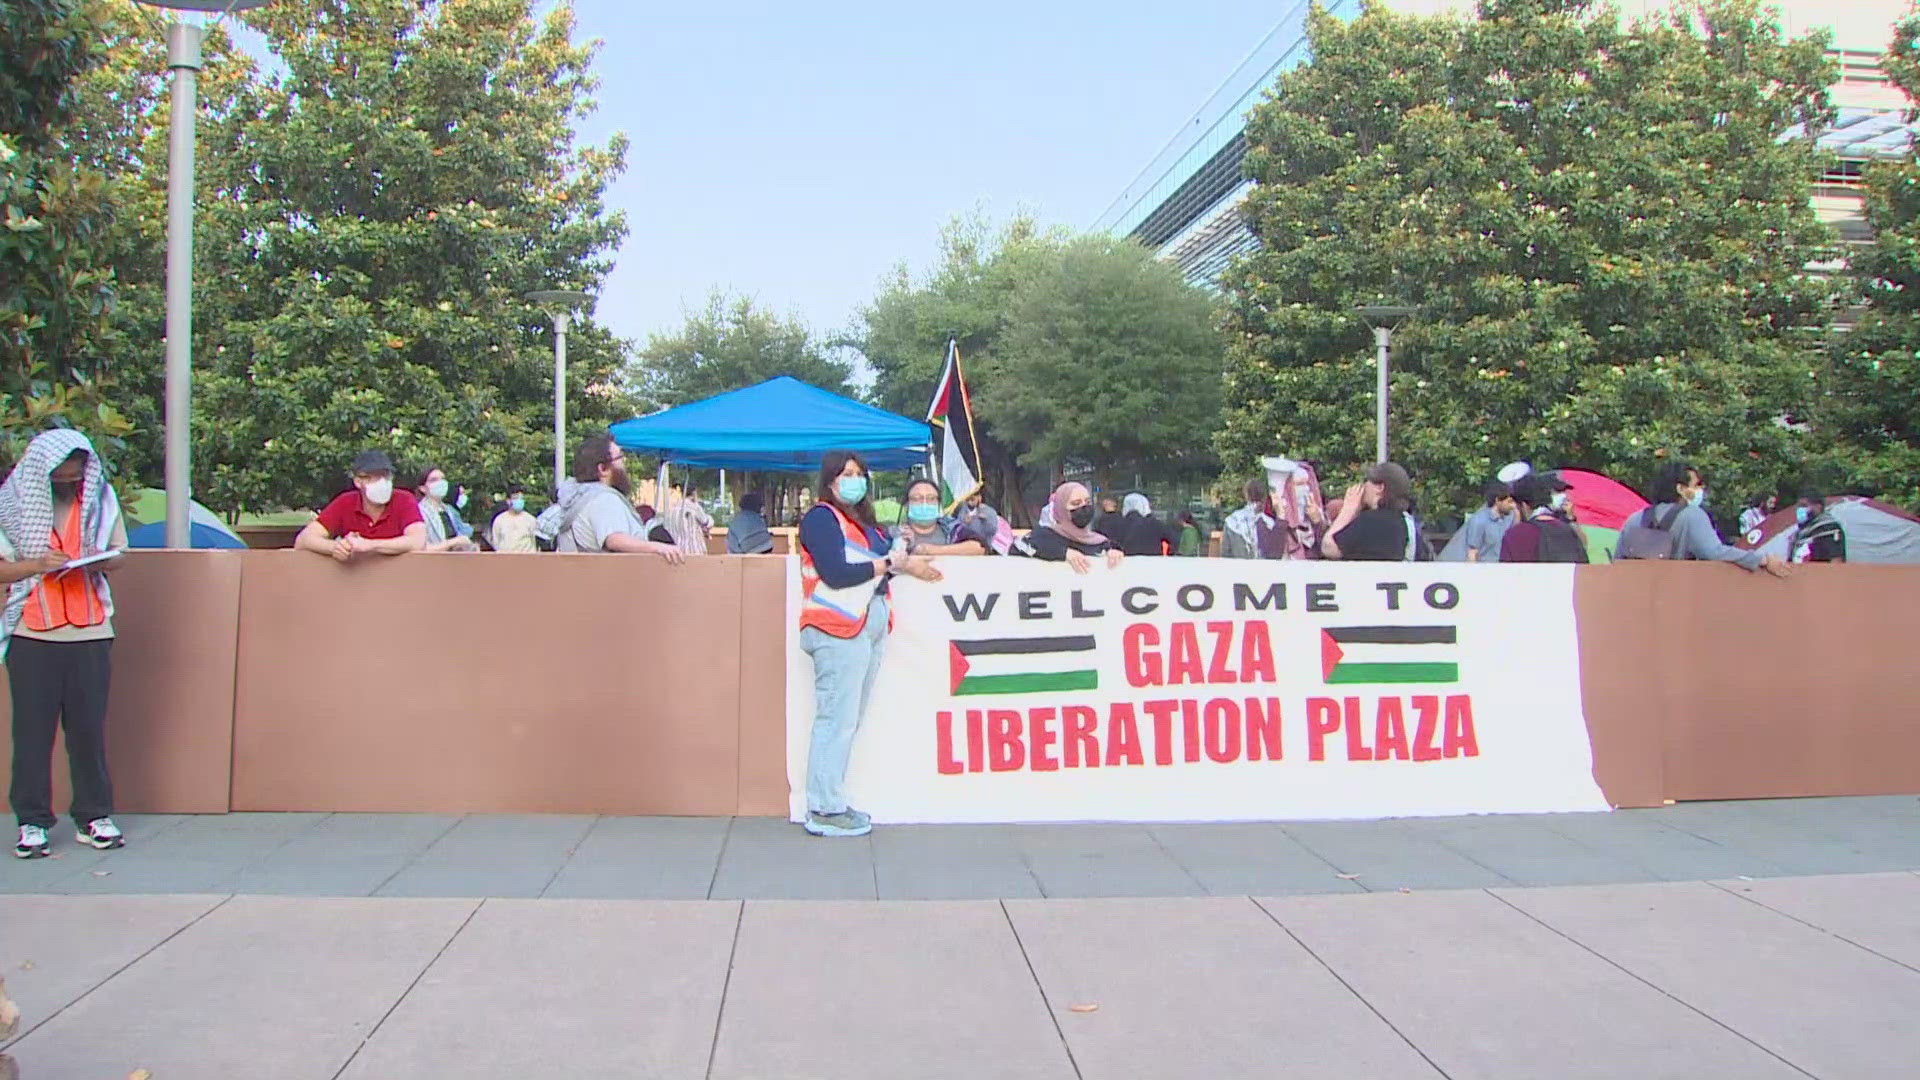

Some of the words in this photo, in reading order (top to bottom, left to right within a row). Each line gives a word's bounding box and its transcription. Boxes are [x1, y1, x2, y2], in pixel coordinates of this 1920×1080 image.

[943, 583, 1339, 621] WELCOME
[1377, 582, 1460, 610] TO
[1123, 620, 1276, 688] GAZA
[937, 696, 1283, 775] LIBERATION
[1306, 695, 1479, 762] PLAZA
